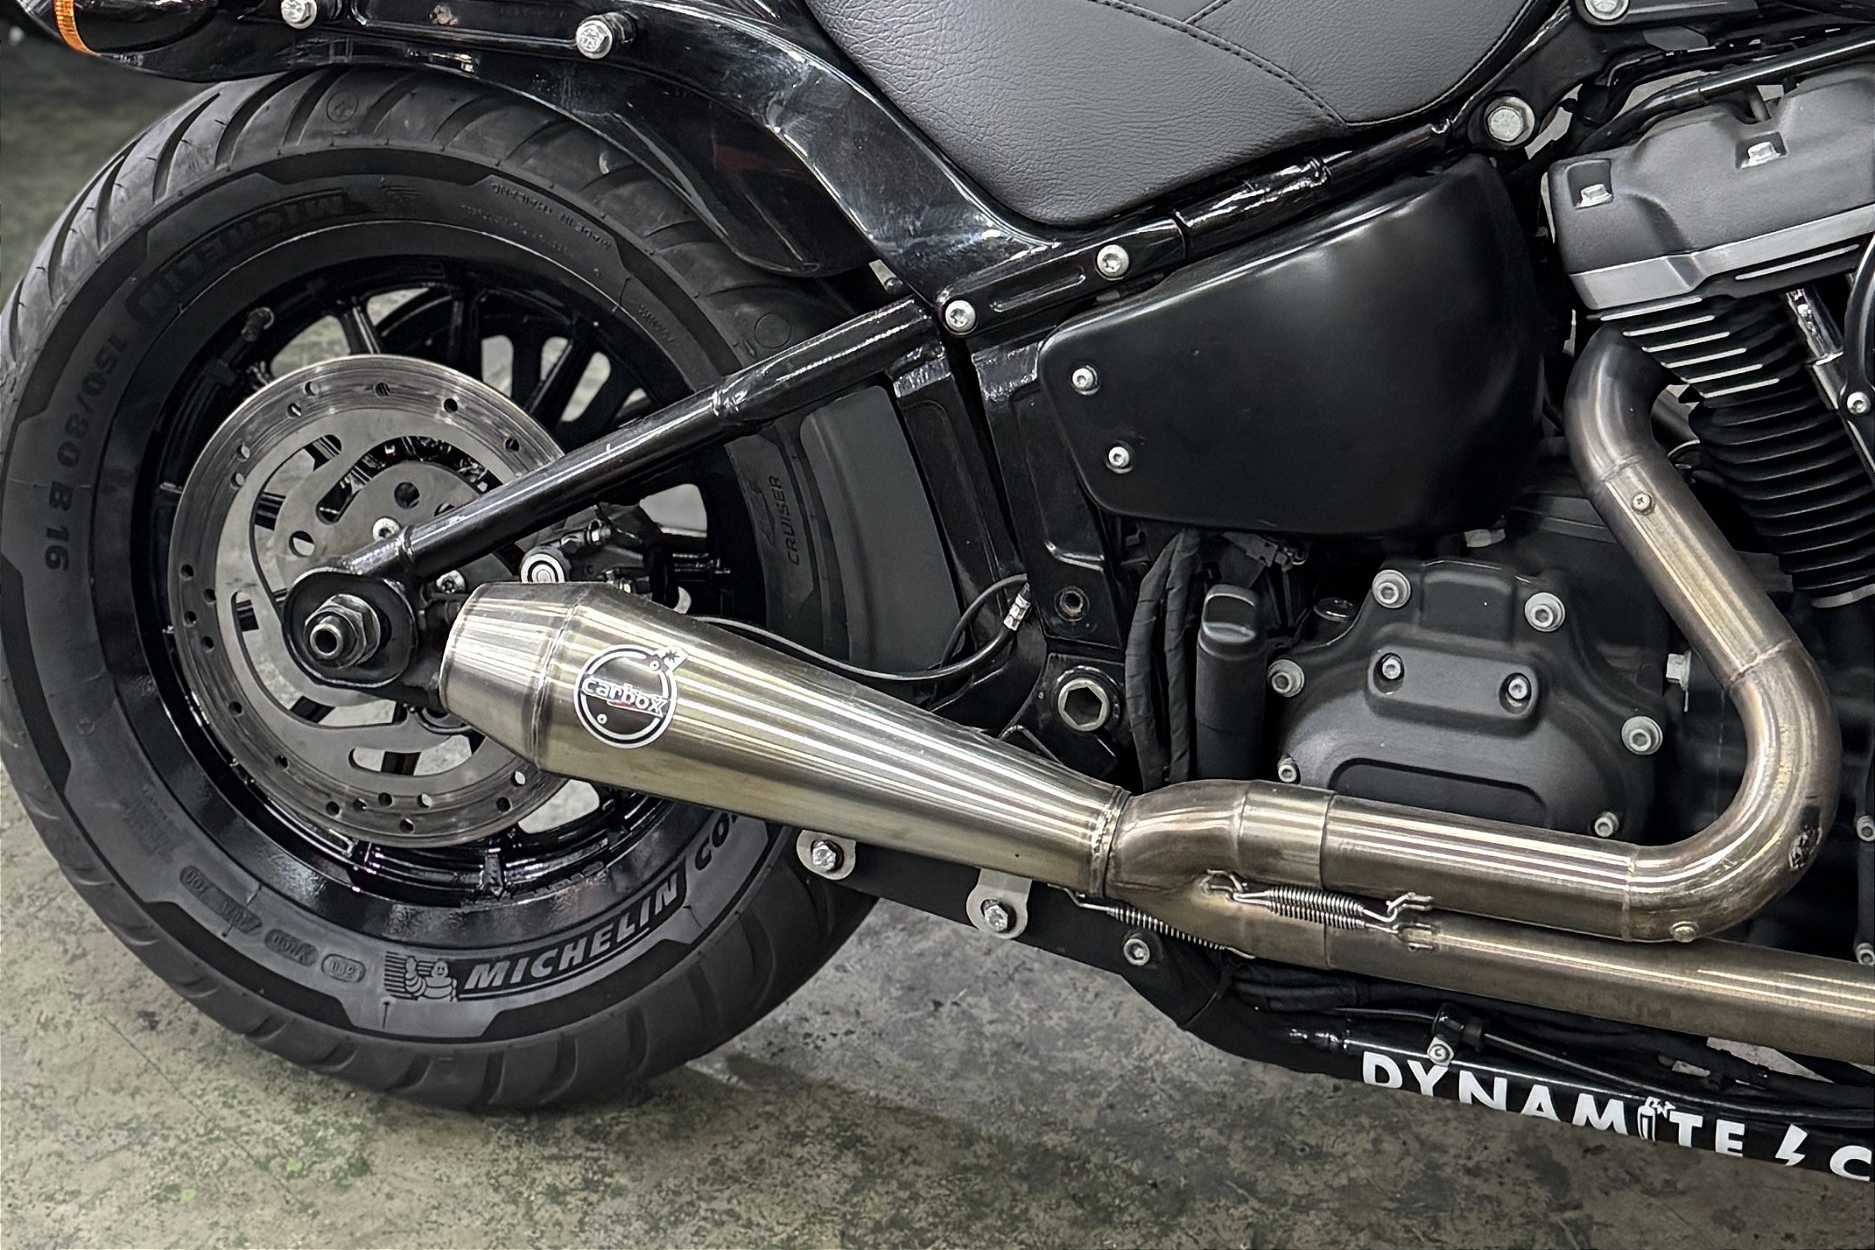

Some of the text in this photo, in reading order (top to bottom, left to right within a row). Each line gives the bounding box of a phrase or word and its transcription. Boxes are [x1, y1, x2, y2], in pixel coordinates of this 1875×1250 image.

[49, 481, 73, 512] B
[768, 475, 800, 567] CRUISER
[45, 526, 70, 572] 16
[464, 869, 680, 992] MICHELIN
